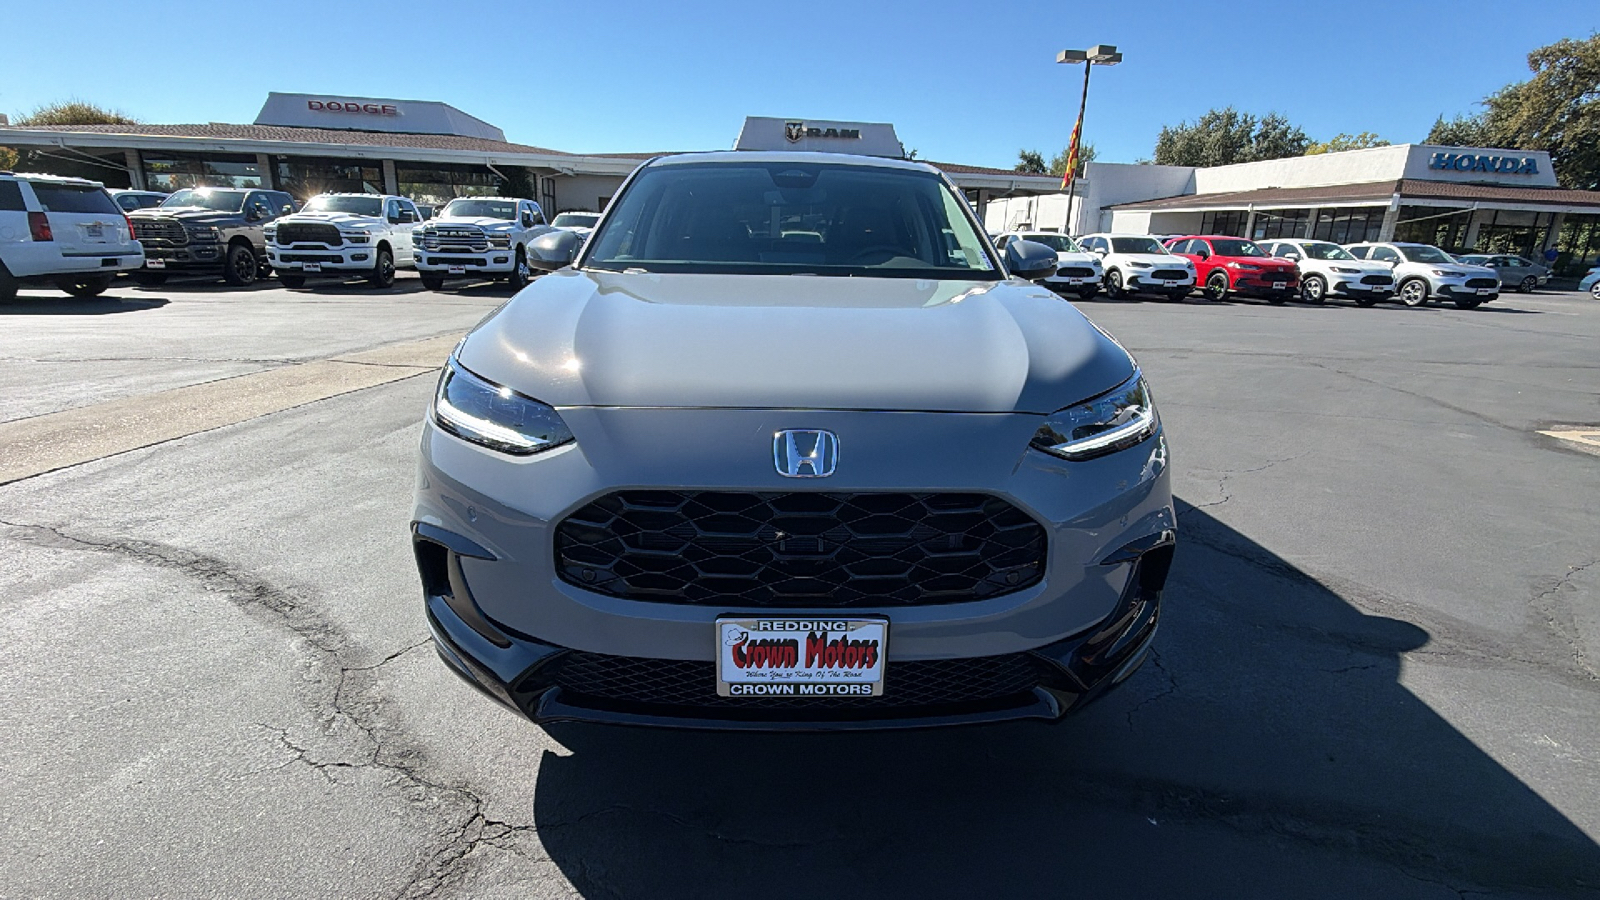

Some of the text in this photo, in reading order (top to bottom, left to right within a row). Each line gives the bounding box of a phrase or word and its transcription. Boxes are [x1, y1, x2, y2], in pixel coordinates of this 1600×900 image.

[308, 101, 397, 115] DODGE
[807, 128, 859, 138] RAM
[1429, 153, 1539, 174] HONDA
[759, 621, 846, 631] REDDING
[732, 631, 878, 669] Crown Motors
[795, 671, 813, 679] King
[816, 670, 825, 679] Of
[828, 670, 841, 678] The
[730, 684, 872, 695] CROWN MOTORS
